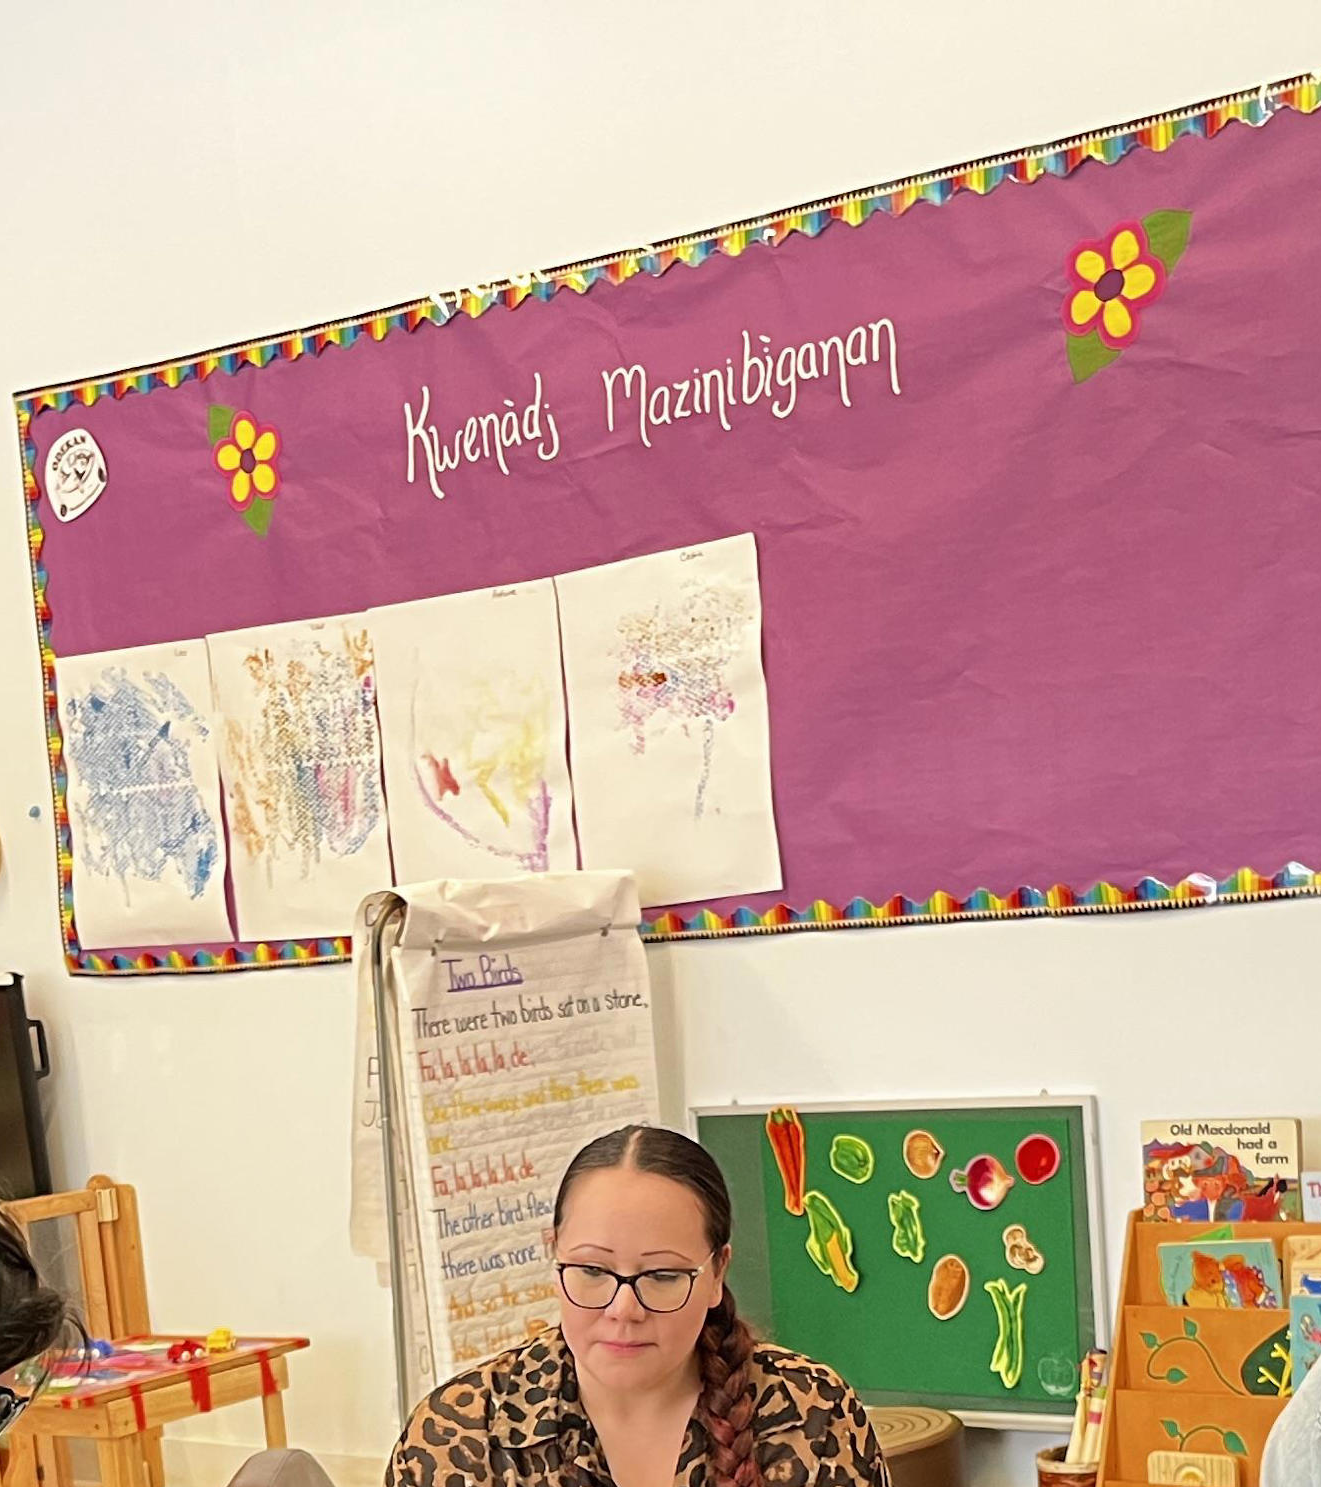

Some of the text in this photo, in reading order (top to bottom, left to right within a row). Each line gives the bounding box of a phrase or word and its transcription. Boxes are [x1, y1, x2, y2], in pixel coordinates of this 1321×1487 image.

[441, 954, 523, 990] Two Birds
[411, 1008, 451, 1039] There
[455, 1012, 488, 1034] were
[490, 1001, 518, 1029] two
[518, 994, 554, 1023] birds
[1170, 1122, 1271, 1136] Old Macdonald
[1237, 1138, 1277, 1150] had a
[1255, 1153, 1289, 1164] farm
[433, 1208, 461, 1239] The
[462, 1202, 494, 1234] other
[497, 1197, 524, 1226] bird
[441, 1252, 477, 1280] there
[480, 1254, 505, 1272] was
